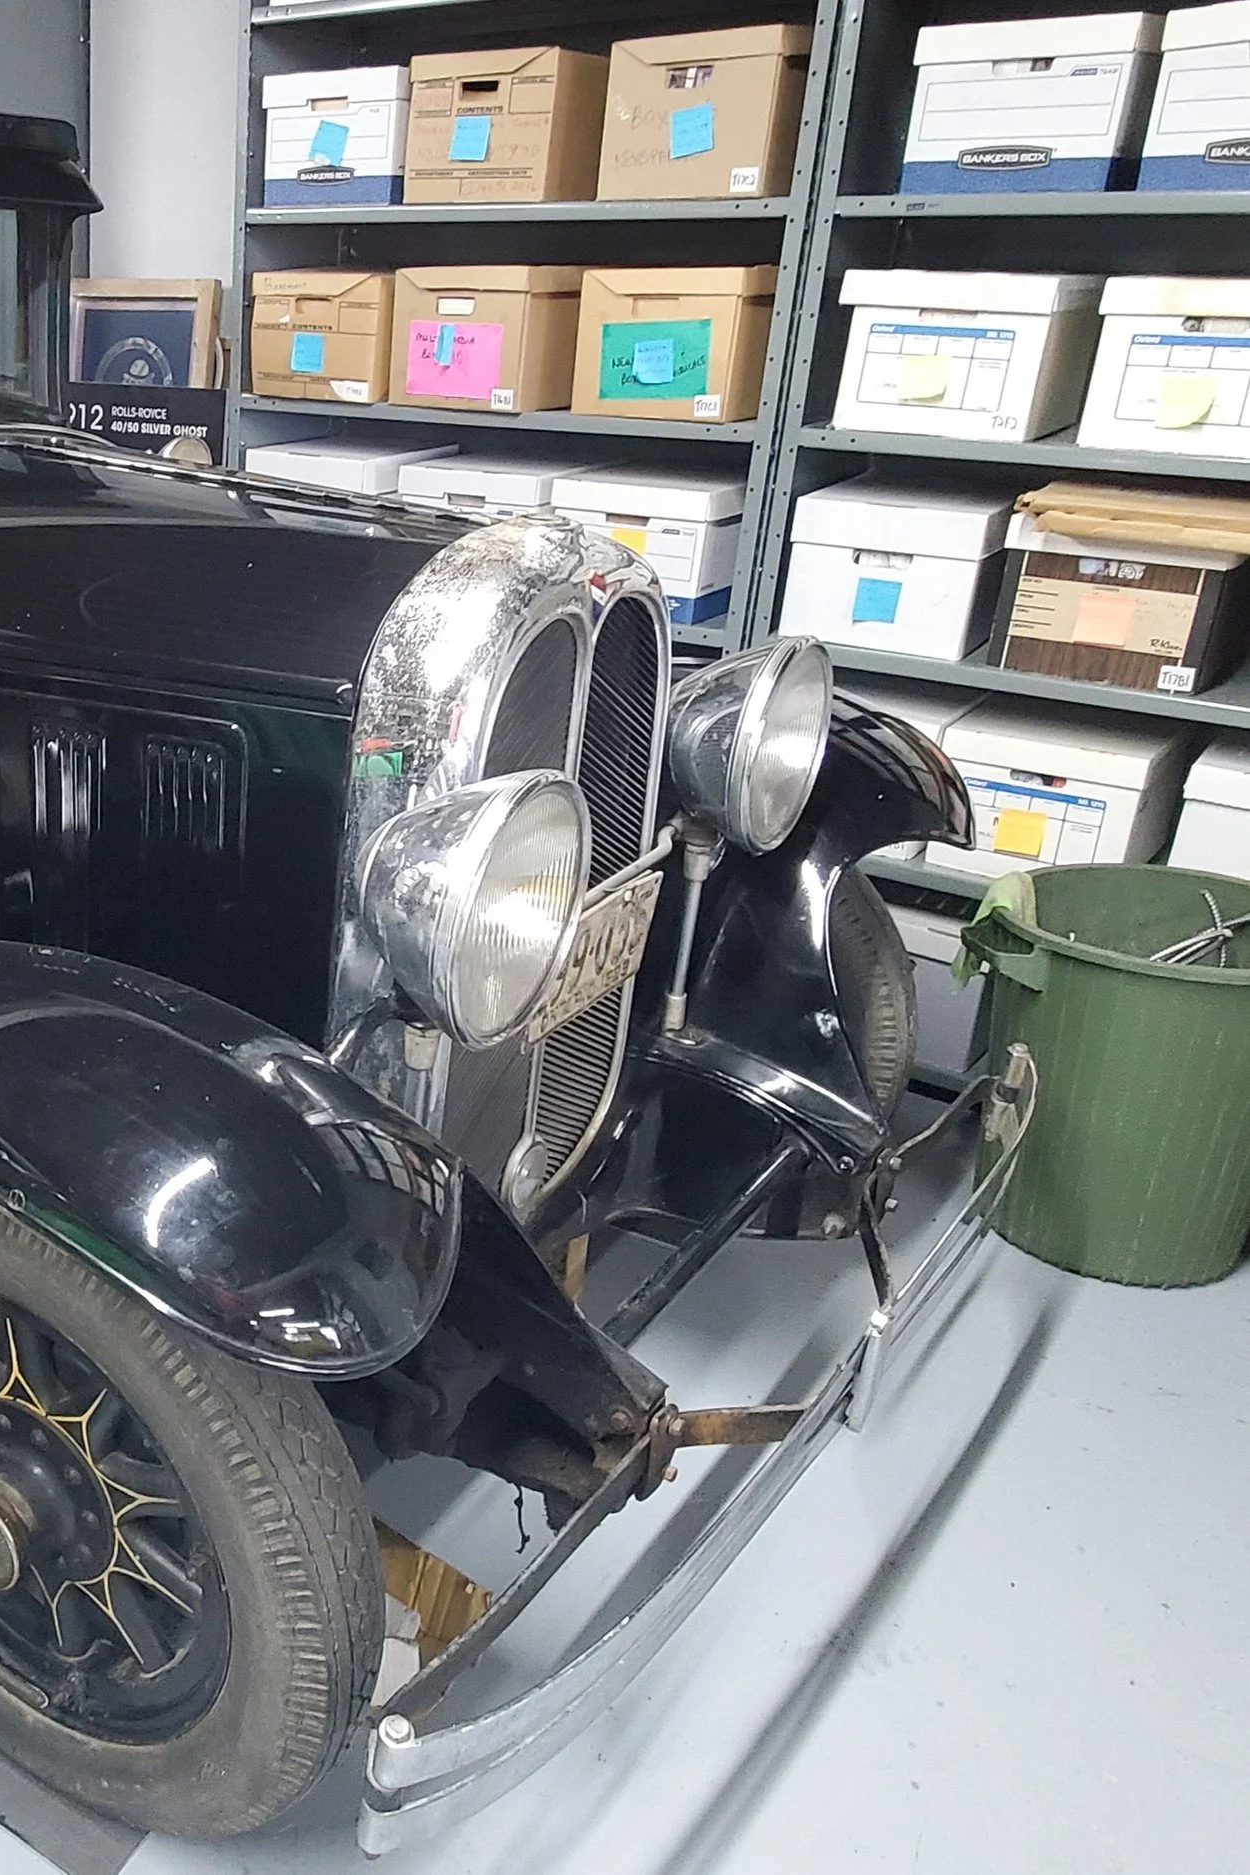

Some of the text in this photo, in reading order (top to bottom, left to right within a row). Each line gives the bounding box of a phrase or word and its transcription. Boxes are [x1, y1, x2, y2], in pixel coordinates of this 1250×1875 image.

[456, 105, 504, 115] CONTENTS
[962, 151, 1047, 165] BANKERS BOX
[111, 405, 168, 420] ROLLS-ROYCE
[110, 420, 208, 438] 40/50 SILVER GHOST
[1162, 671, 1190, 688] T17B1
